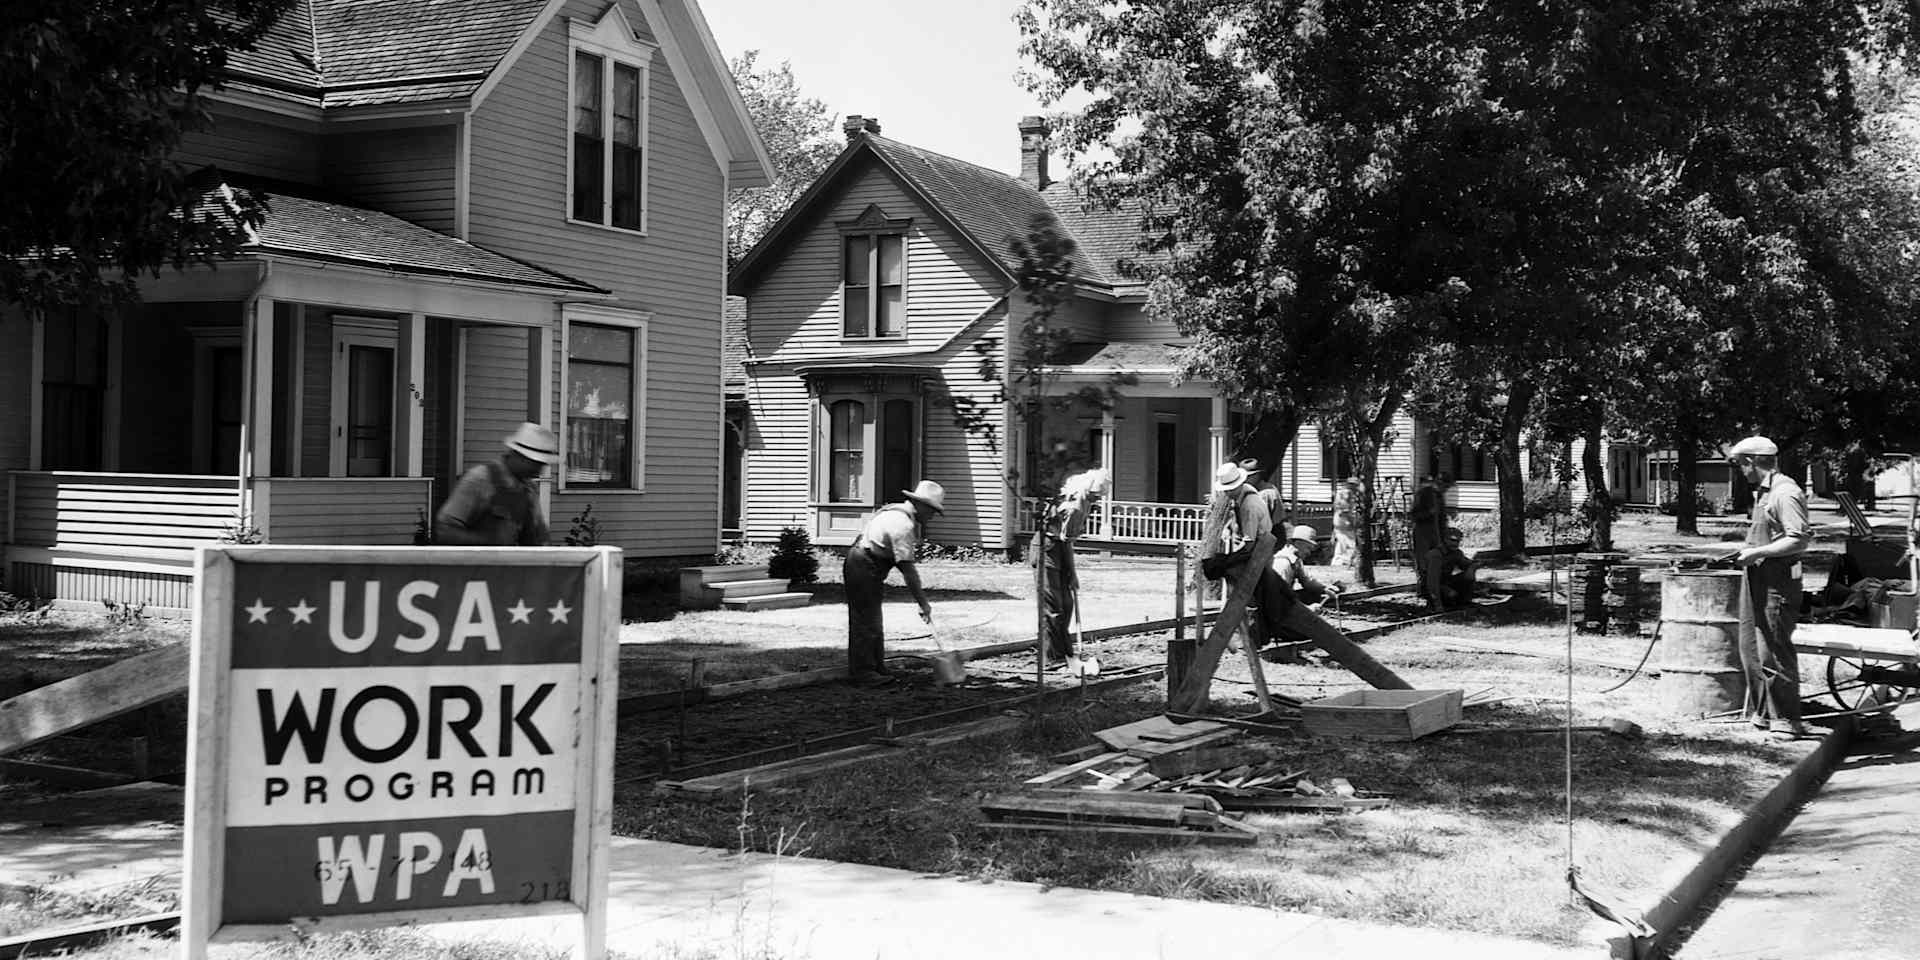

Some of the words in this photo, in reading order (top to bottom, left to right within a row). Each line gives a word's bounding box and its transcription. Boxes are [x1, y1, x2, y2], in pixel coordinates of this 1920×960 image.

[328, 580, 501, 653] USA
[256, 682, 558, 766] WORK
[265, 767, 545, 805] PROGRAM
[317, 828, 495, 905] WPA
